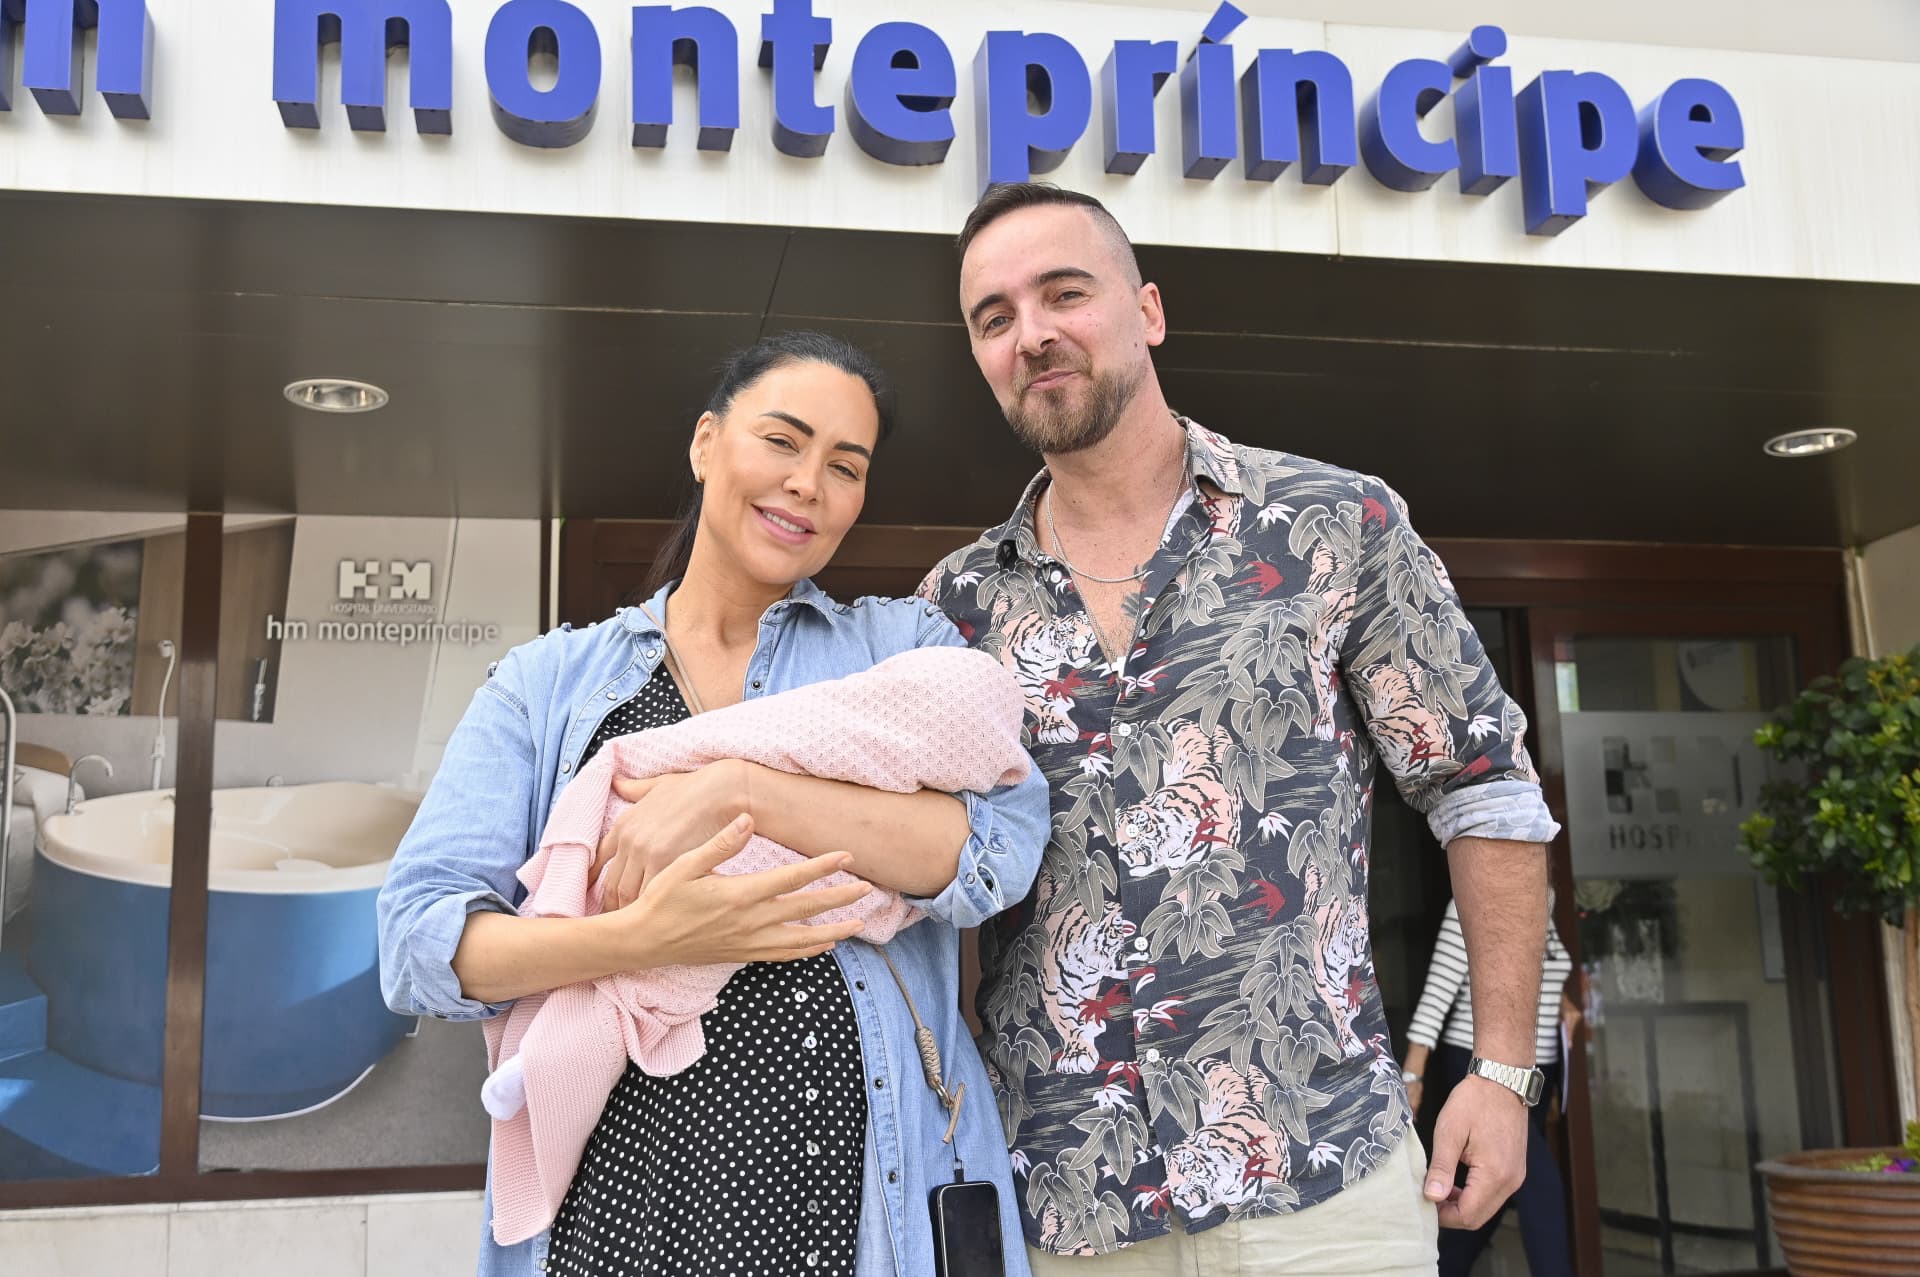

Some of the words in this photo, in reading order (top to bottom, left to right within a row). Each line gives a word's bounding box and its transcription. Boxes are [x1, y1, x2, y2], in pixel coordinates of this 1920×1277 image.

[273, 0, 1744, 237] montepríncipe
[266, 614, 307, 640] hm
[319, 618, 499, 647] montepríncipe
